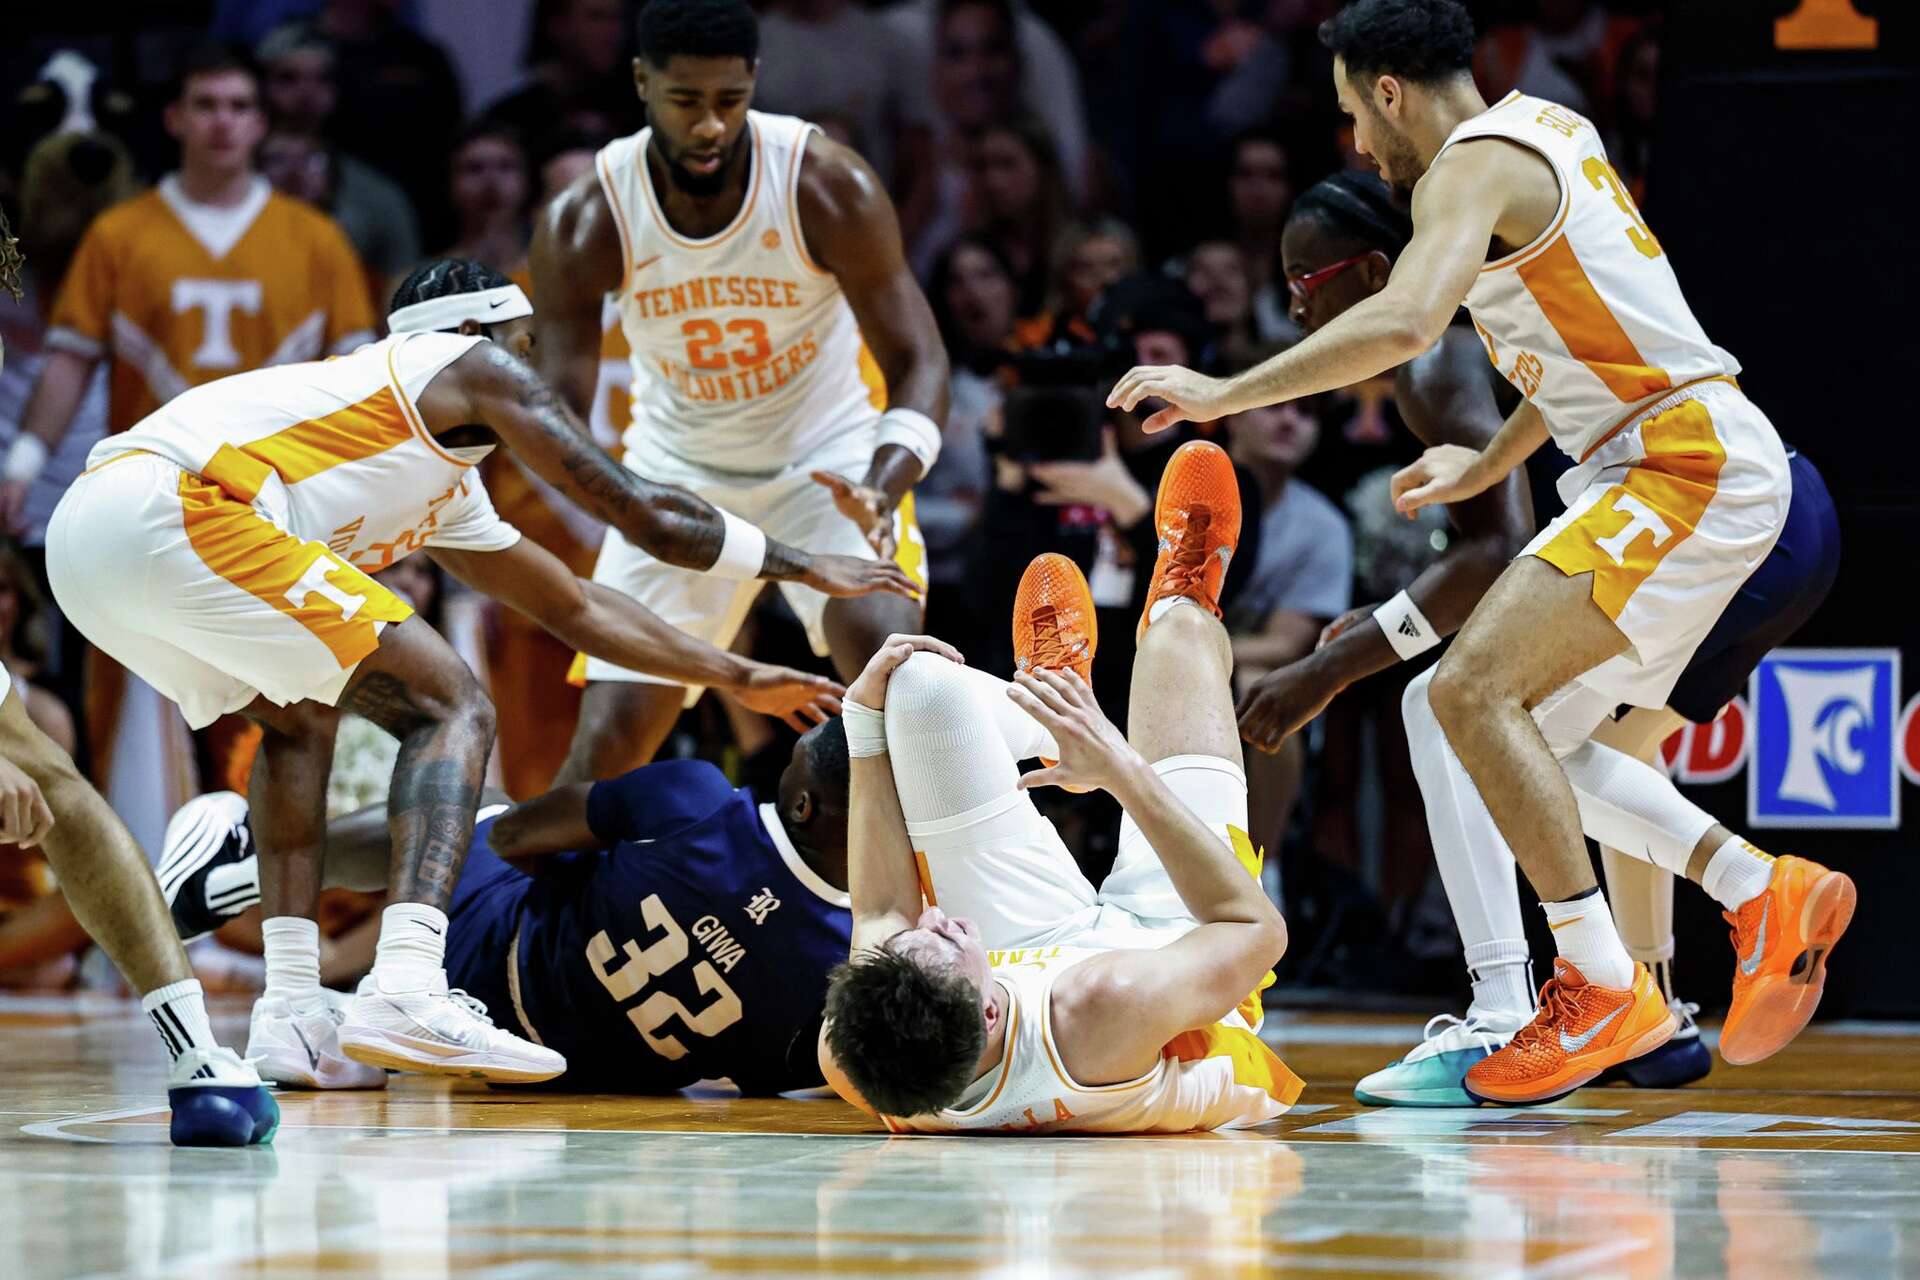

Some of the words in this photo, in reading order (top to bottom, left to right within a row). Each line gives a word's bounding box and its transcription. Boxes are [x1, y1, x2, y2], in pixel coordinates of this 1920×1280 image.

[1581, 152, 1663, 260] 3
[171, 279, 263, 368] T
[634, 275, 801, 319] TENNESSEE
[681, 318, 772, 370] 23
[1595, 493, 1674, 567] T
[283, 554, 368, 622] T
[585, 893, 743, 1061] 32
[691, 914, 747, 974] GIWA
